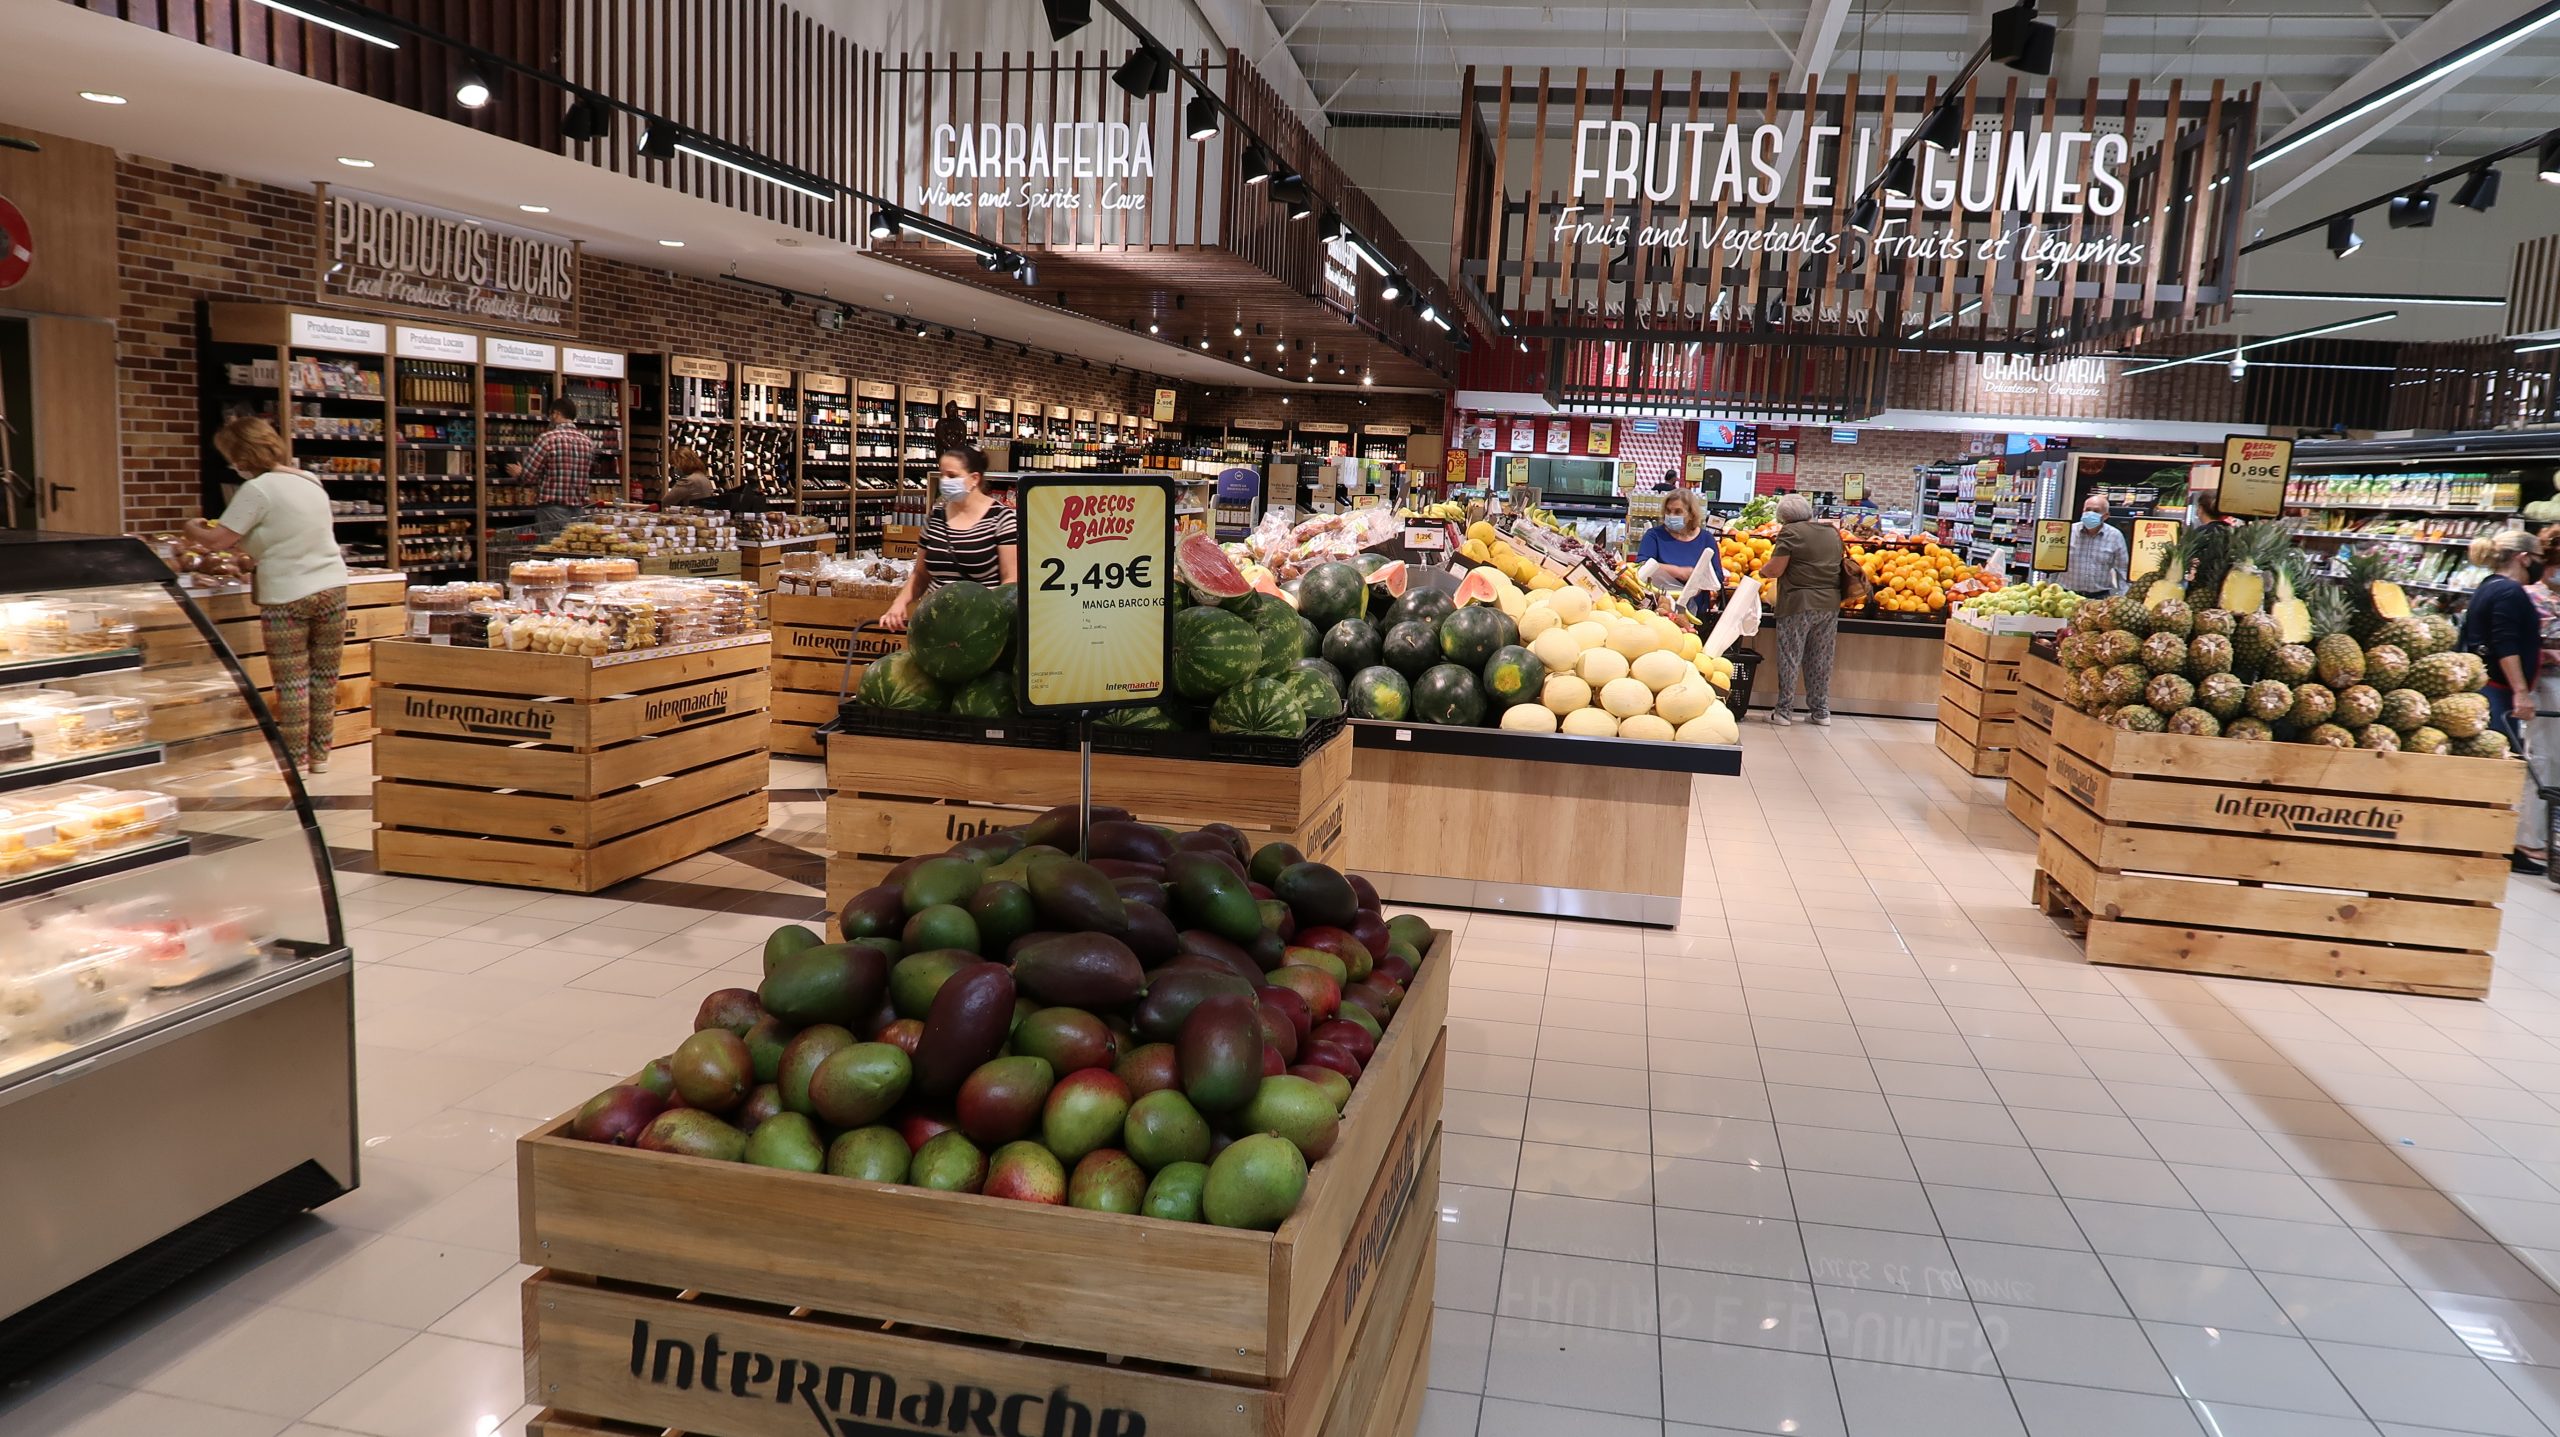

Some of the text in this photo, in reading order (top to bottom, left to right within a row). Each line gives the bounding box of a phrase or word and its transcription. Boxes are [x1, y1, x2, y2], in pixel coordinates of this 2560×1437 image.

[933, 122, 1153, 178] GARRAFEIRA
[1573, 120, 1783, 204] FRUTAS
[1803, 126, 1840, 205] E
[918, 182, 1145, 220] Wines and Spirits Cave
[334, 197, 572, 300] PRODUTOS LOCAIS
[1554, 207, 2145, 280] Fruit and Vegetables Fruits et Légumes
[347, 267, 561, 324] Local Products Produits Locaux
[307, 321, 370, 338] Produtos Locais
[410, 333, 464, 349] Produtos Locais
[497, 343, 543, 358] Produtos Locais
[1984, 381, 2039, 394] Delicatessen
[2230, 462, 2281, 477] 0,89€
[1060, 494, 1135, 530] PREÇOS
[1066, 517, 1135, 550] BAIXOS
[2039, 535, 2066, 545] 0,99€
[1040, 555, 1152, 597] 2,49€
[1082, 597, 1166, 610] MANGA BARCO KG
[1105, 680, 1160, 693] Intermarché
[404, 696, 555, 732] Intermarché
[644, 687, 728, 723] Intermarché
[2214, 793, 2404, 831] Intermarché
